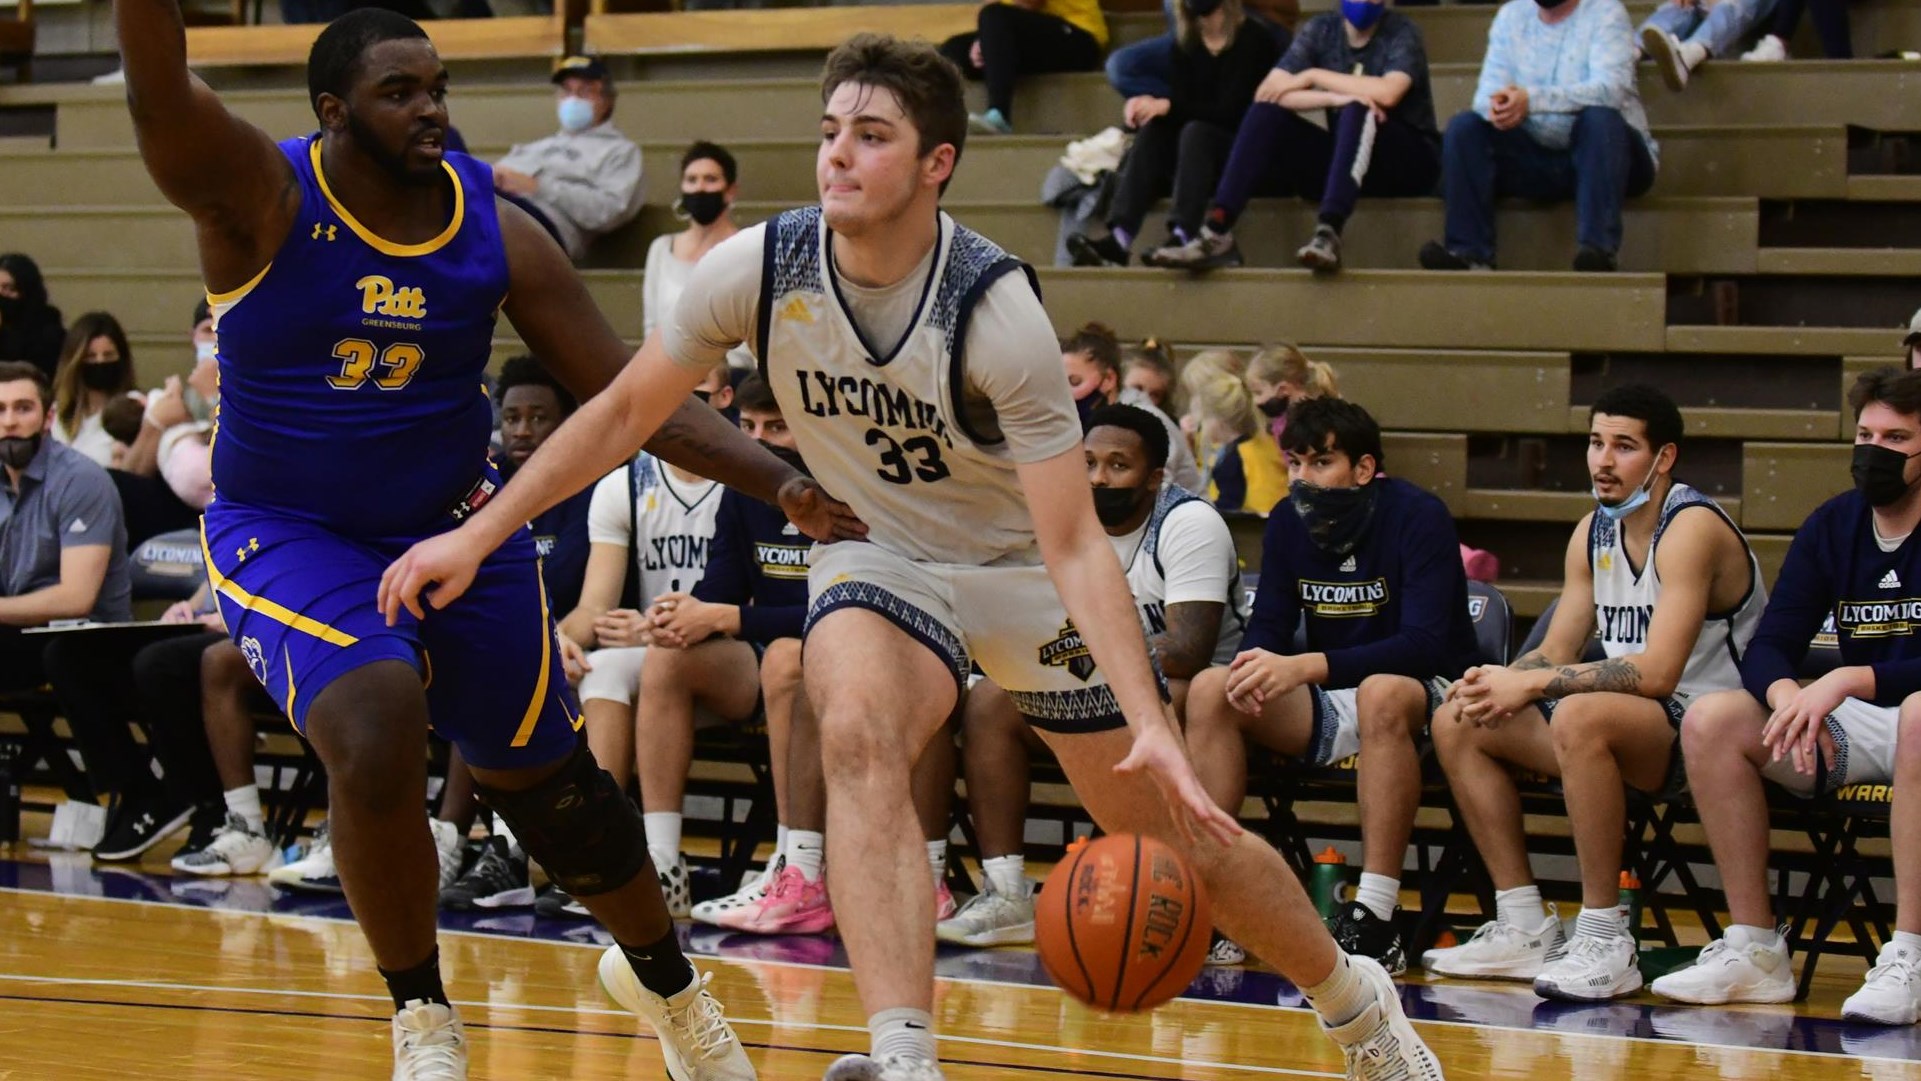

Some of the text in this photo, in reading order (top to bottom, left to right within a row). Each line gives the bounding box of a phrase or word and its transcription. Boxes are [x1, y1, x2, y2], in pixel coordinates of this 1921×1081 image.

[355, 275, 427, 318] Pitt
[361, 318, 421, 331] GREENSBURG
[325, 338, 425, 390] 33
[865, 428, 951, 484] 33
[757, 546, 810, 565] YCOMI
[1302, 580, 1385, 603] LYCOMING
[1595, 604, 1653, 643] YCOM
